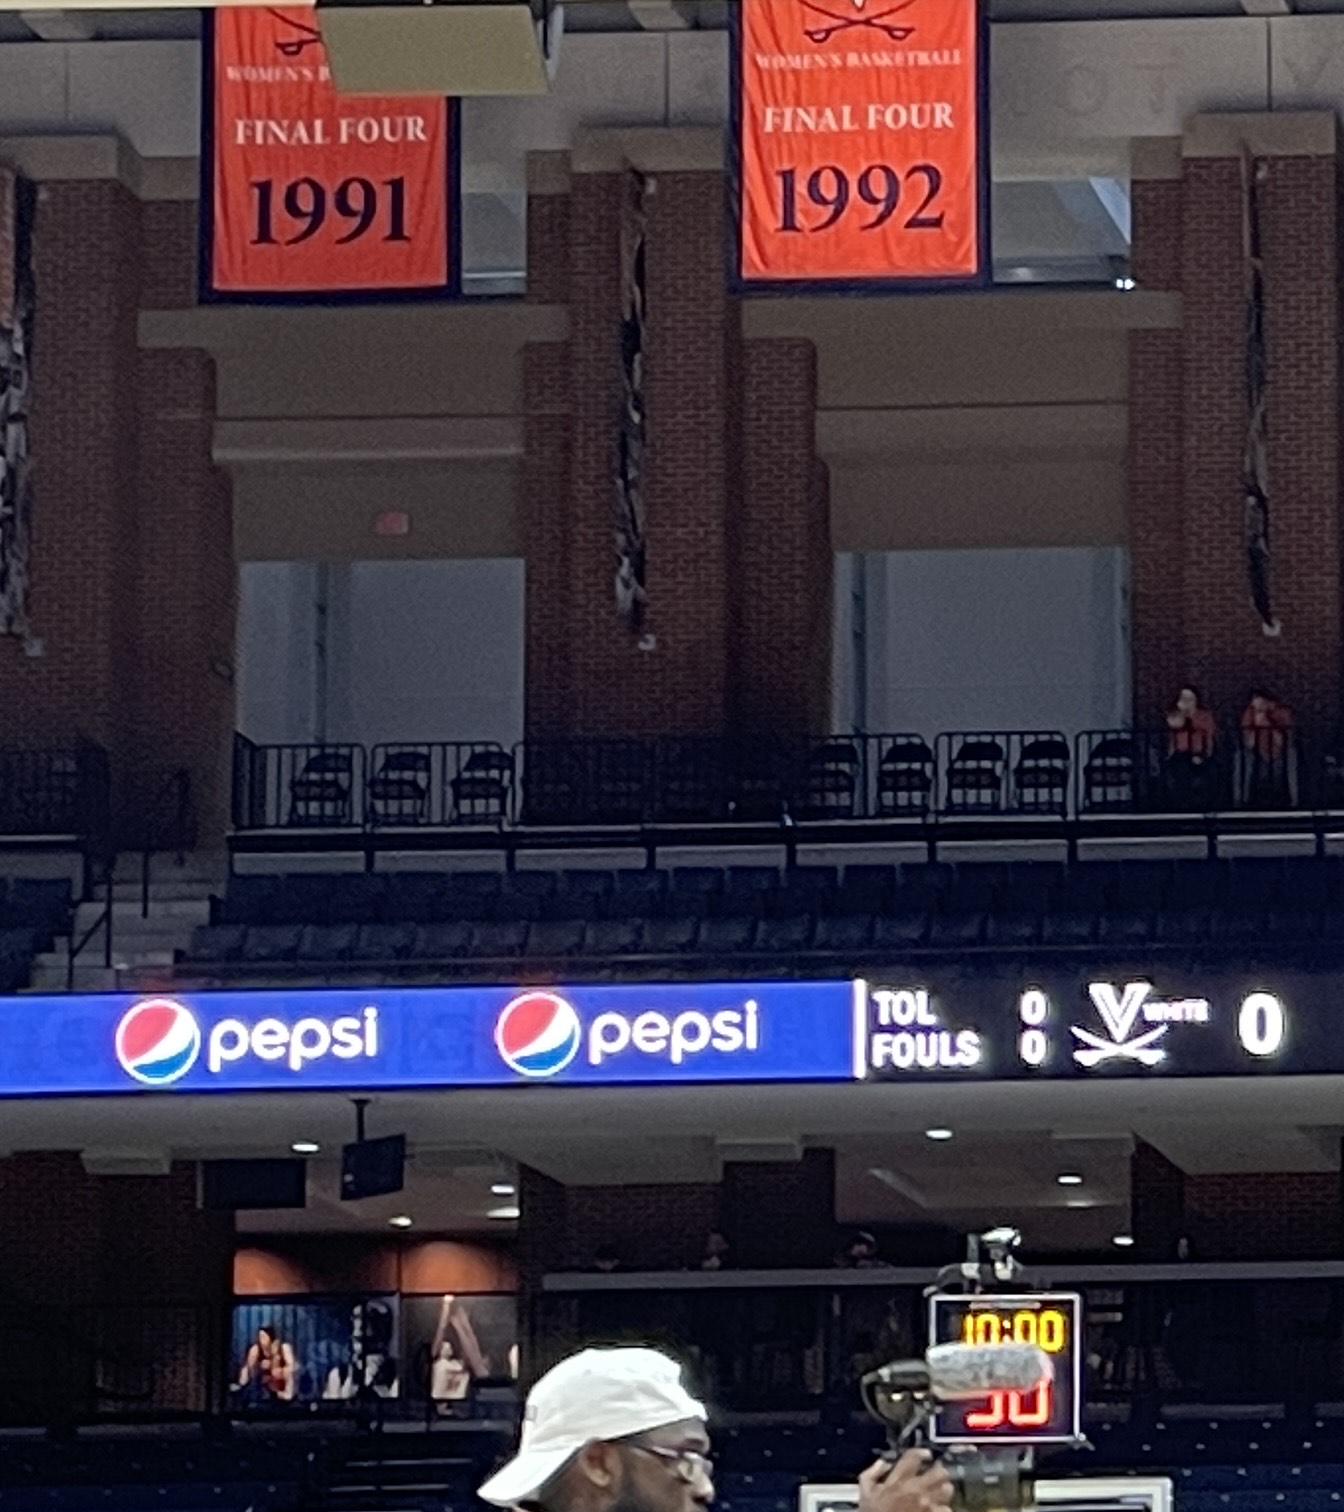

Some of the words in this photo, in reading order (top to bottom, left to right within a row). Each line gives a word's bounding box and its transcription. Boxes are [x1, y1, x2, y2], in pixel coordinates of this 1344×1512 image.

[234, 117, 332, 146] FINAL
[338, 115, 429, 145] FOUR
[763, 104, 860, 133] FINAL
[867, 101, 955, 131] FOUR
[250, 176, 412, 247] 1991
[774, 163, 946, 234] 1992
[588, 1000, 760, 1065] pepsi
[872, 990, 936, 1026] TOL
[1020, 989, 1049, 1025] 0
[1238, 992, 1284, 1057] 0
[209, 1006, 379, 1073] pepsi
[872, 1029, 983, 1068] FOULS
[1020, 1029, 1049, 1065] 0
[962, 1309, 1067, 1354] 10:00
